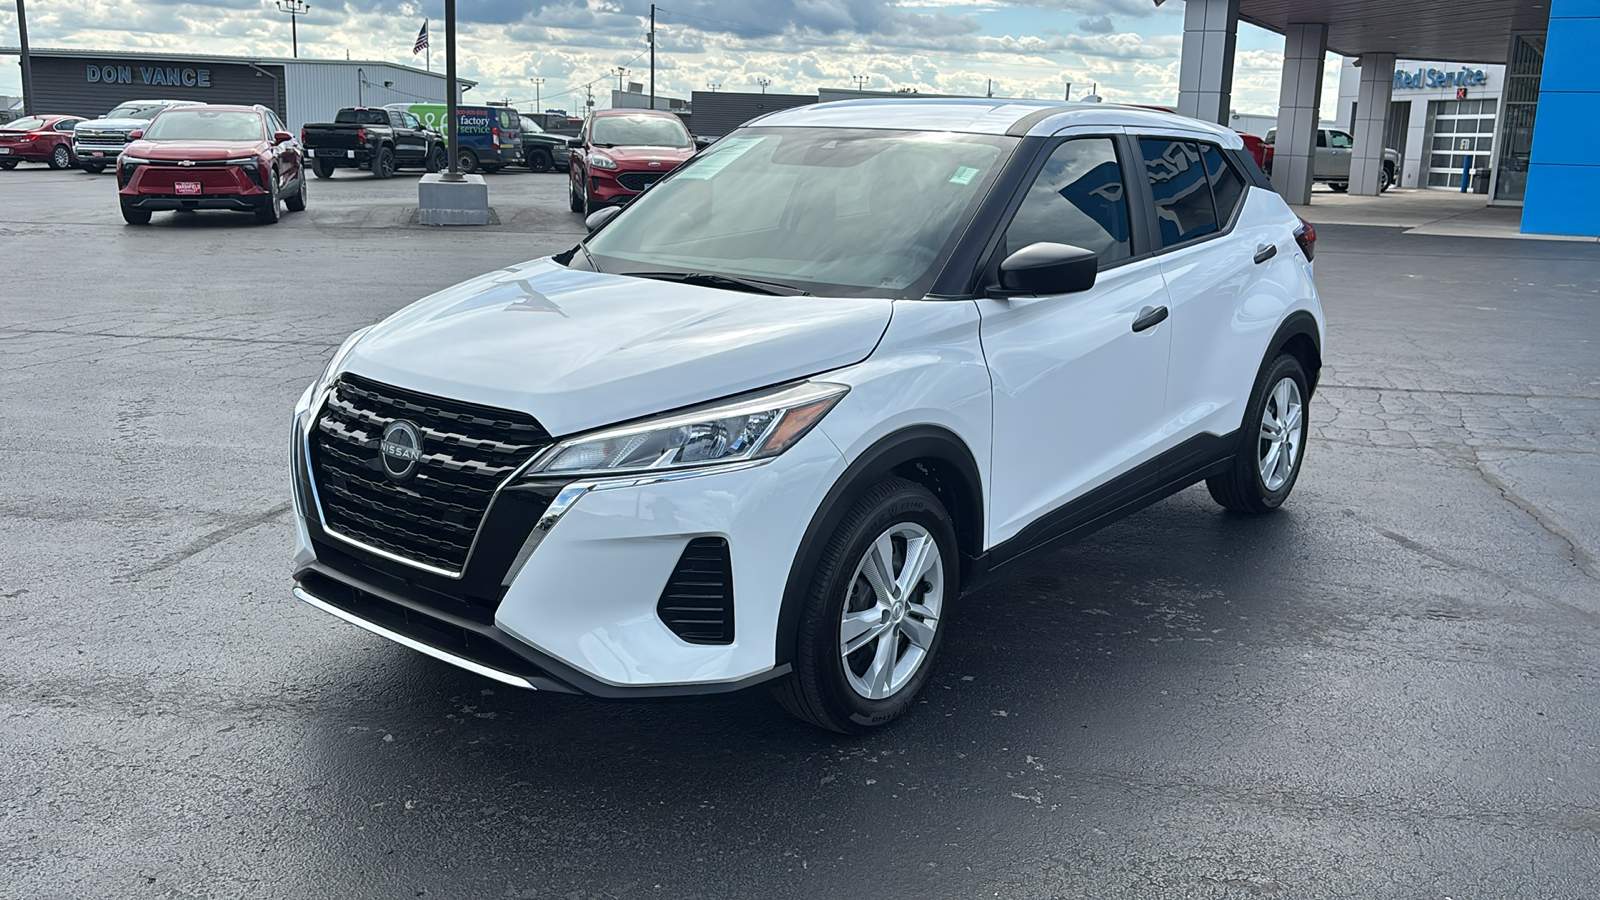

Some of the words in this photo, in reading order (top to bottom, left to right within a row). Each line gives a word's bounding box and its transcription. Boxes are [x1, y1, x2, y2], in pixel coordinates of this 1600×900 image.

[87, 65, 132, 83] DON
[141, 67, 210, 87] VANCE
[1393, 68, 1422, 90] fied
[1426, 66, 1484, 87] Service
[461, 116, 490, 127] factory
[380, 442, 419, 460] NISSAN
